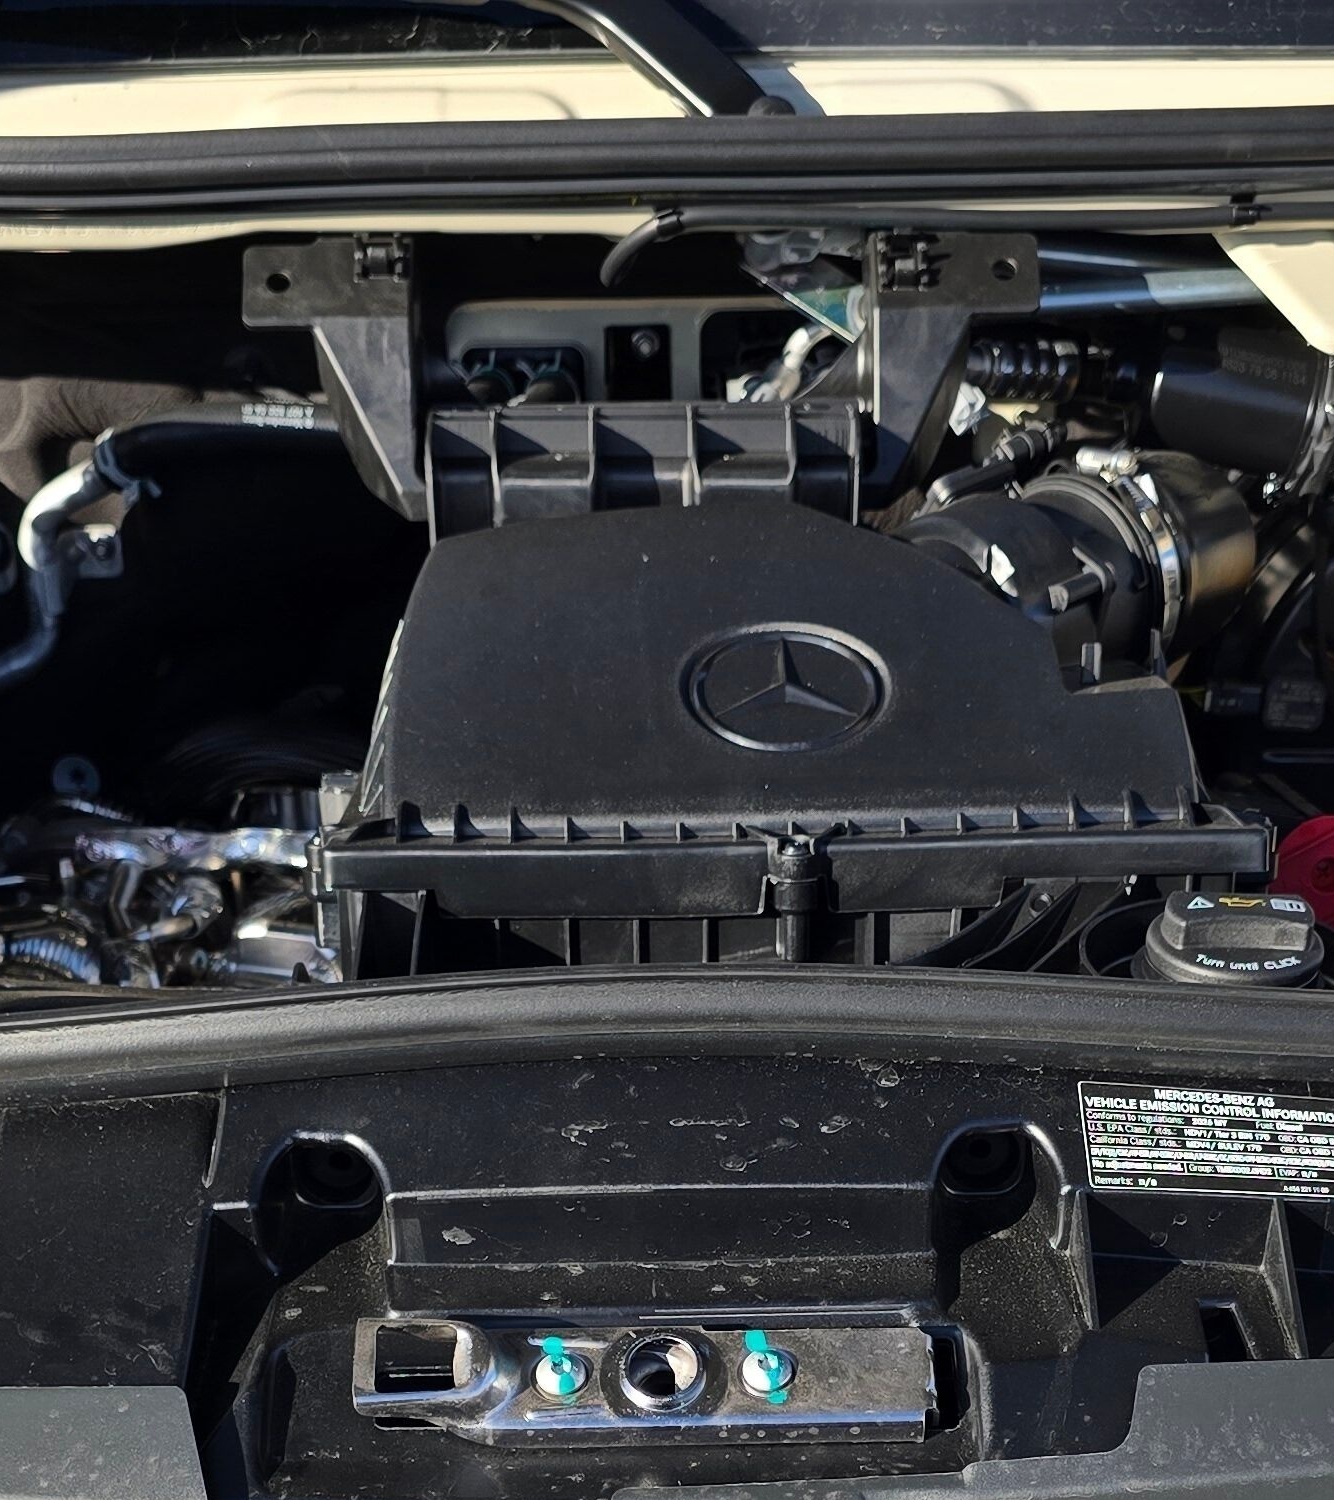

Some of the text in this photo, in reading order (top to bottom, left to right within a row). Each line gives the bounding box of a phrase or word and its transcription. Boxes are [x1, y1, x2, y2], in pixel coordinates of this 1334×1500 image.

[1196, 954, 1301, 971] Turn until CLICK
[1084, 1096, 1137, 1110] VEHICLE
[1139, 1099, 1199, 1114] EMISSION
[1202, 1104, 1259, 1118] CONTROL
[1154, 1089, 1275, 1107] MERCEDES-BENZ AG
